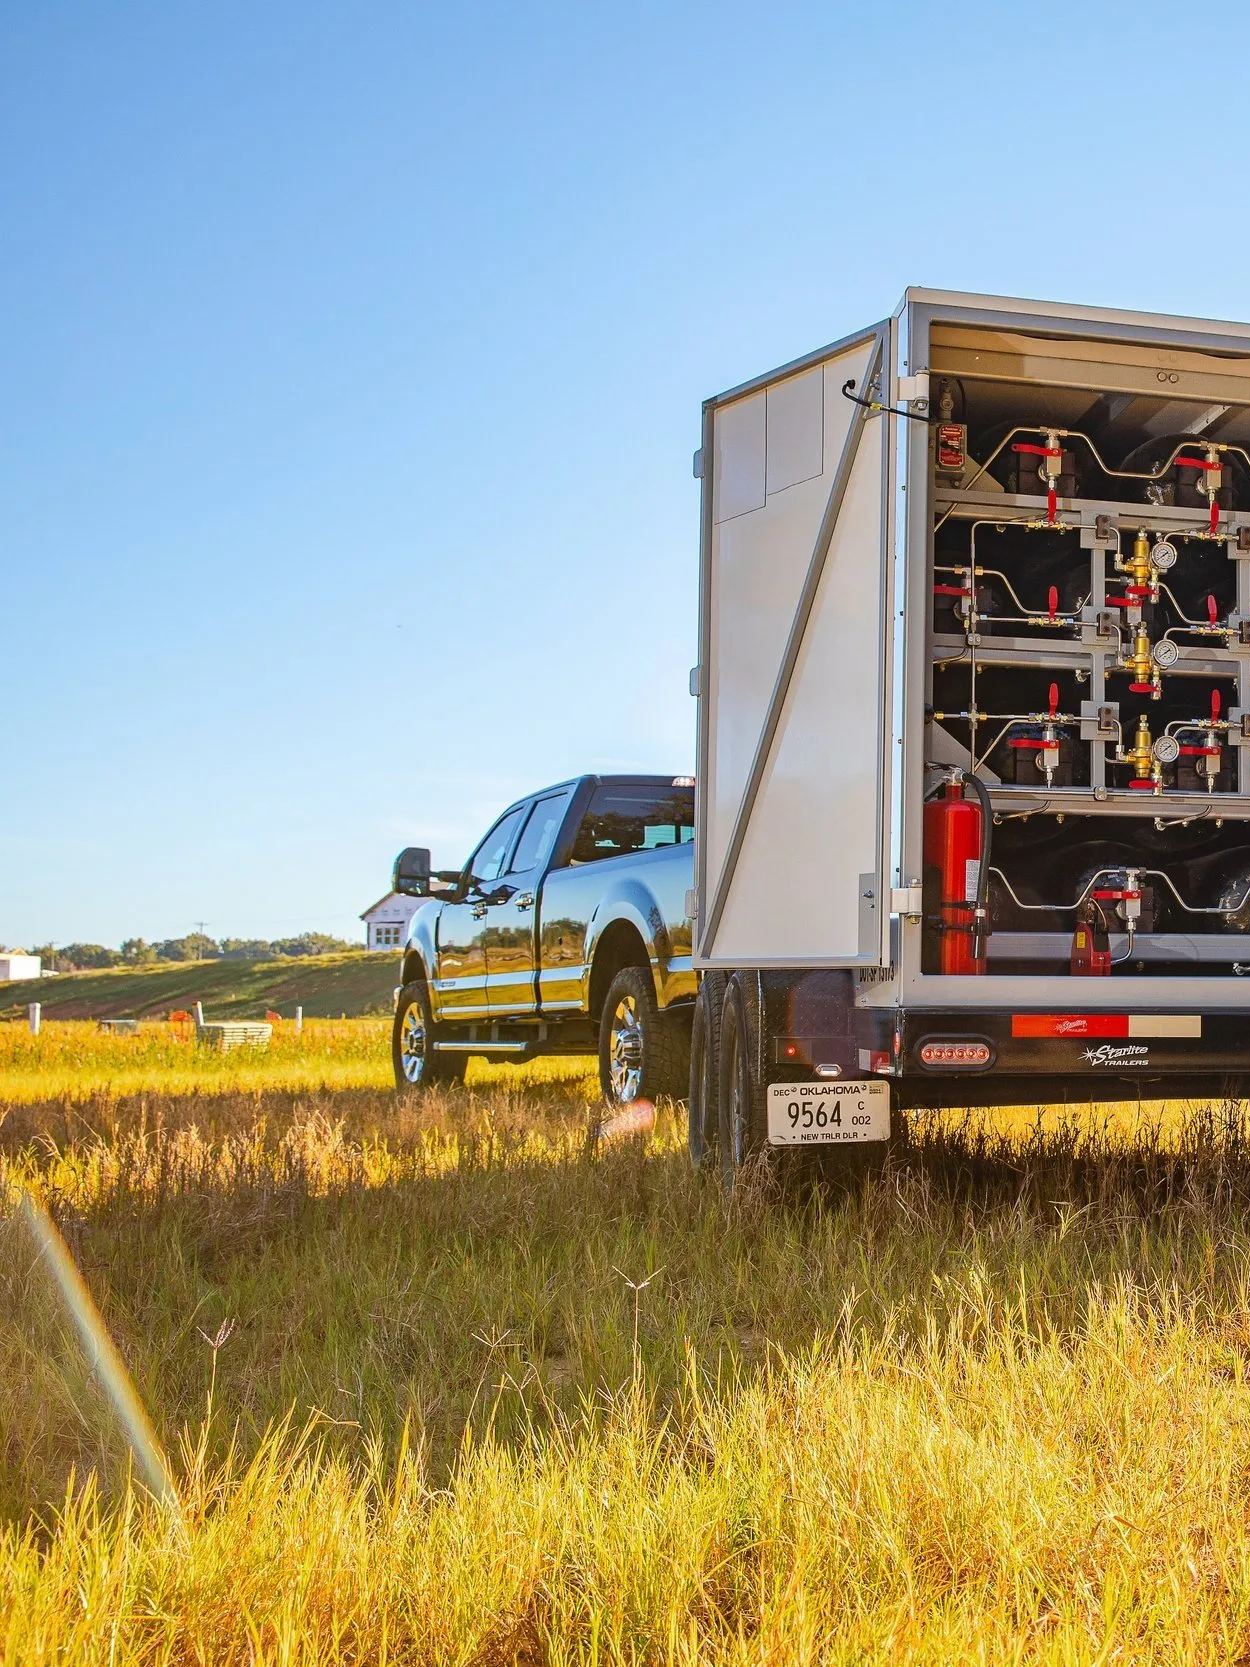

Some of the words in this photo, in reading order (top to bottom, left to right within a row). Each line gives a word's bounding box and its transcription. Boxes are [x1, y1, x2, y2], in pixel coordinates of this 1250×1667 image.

[1091, 1045, 1149, 1066] Starlite
[800, 1086, 861, 1096] OKLAHOMA
[787, 1101, 842, 1128] 9564
[857, 1101, 865, 1110] C
[851, 1115, 871, 1125] 002
[800, 1133, 818, 1141] NEW
[821, 1132, 841, 1140] TRLR
[843, 1131, 858, 1139] DLR
